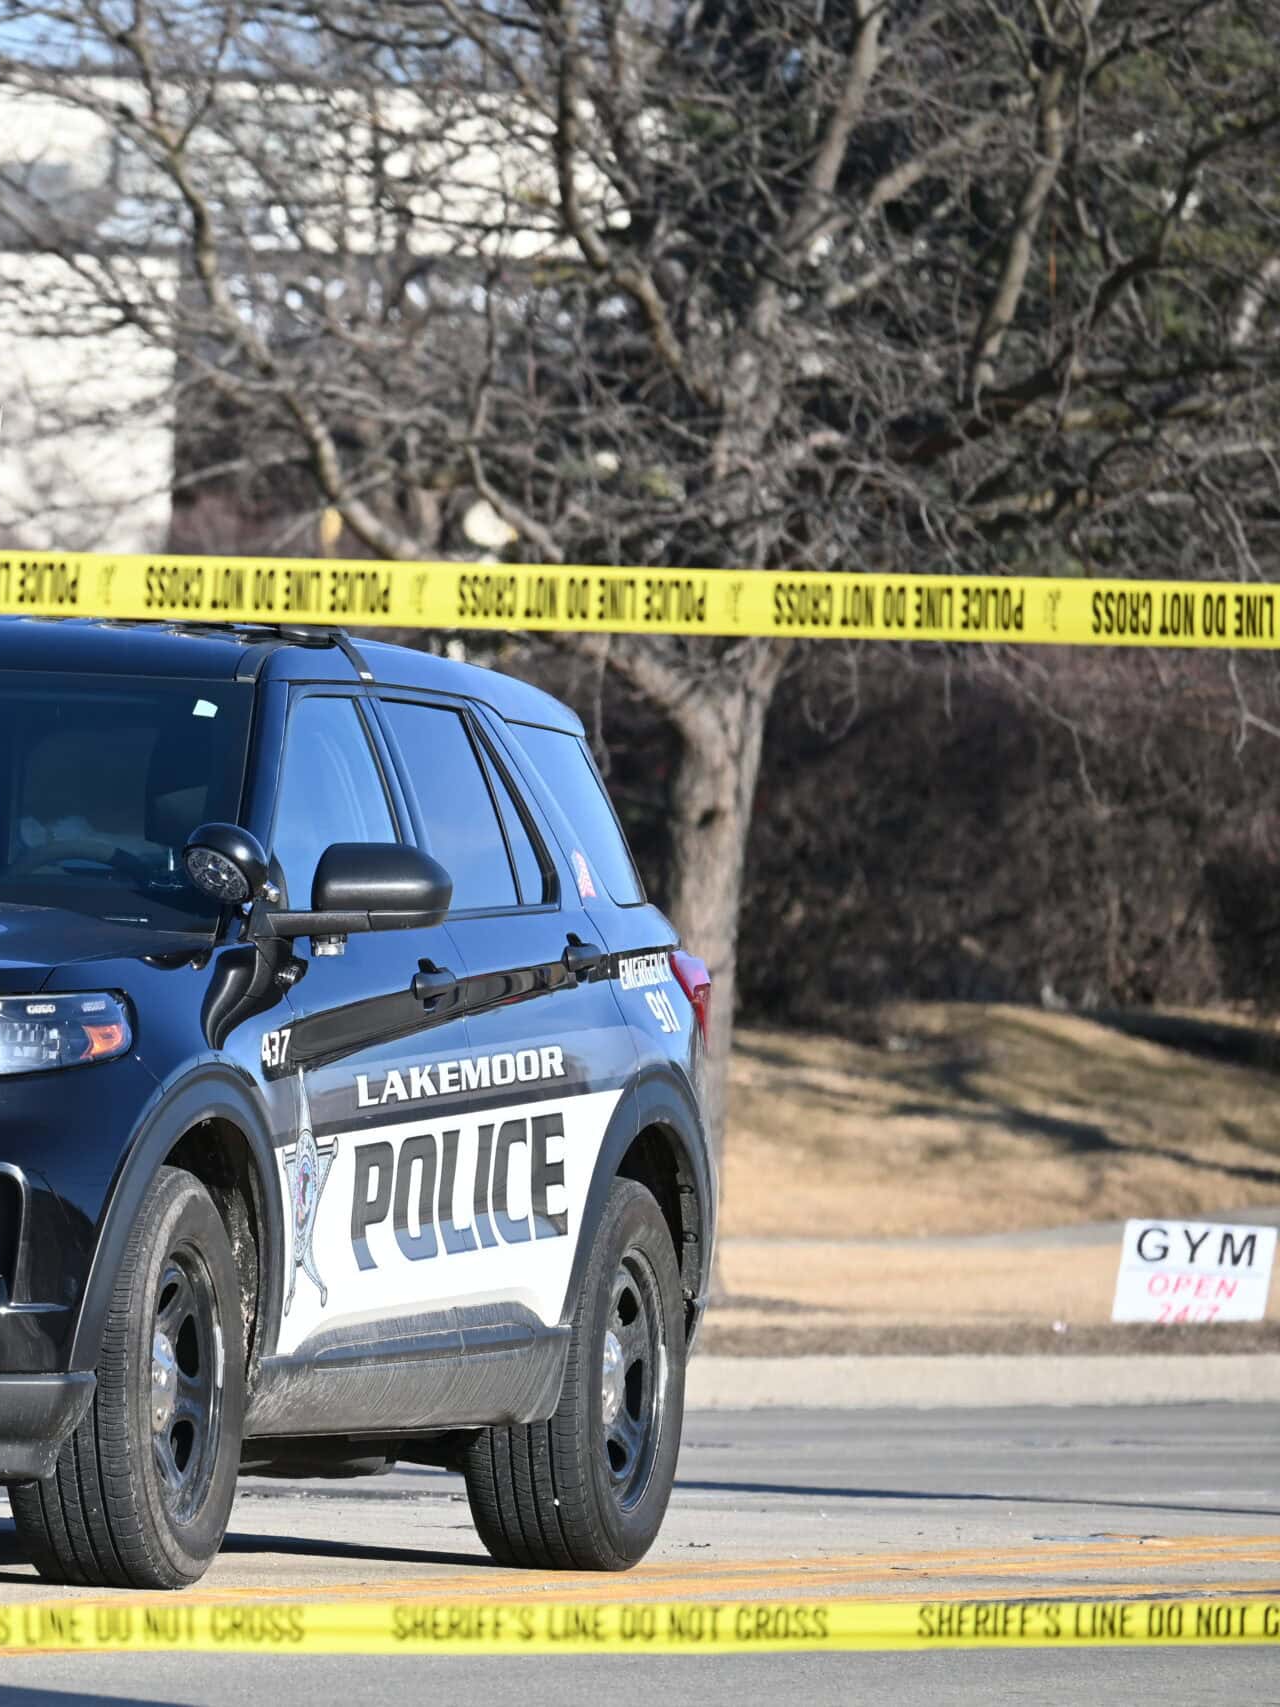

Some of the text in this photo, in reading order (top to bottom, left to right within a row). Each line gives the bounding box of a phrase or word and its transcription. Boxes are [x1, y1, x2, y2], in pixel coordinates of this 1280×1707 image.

[773, 584, 1025, 630] POLICE LINE DO NOT CROSS
[1091, 591, 1275, 638] LINE DO NOT CROSS
[618, 952, 673, 990] EMERGENCY
[643, 989, 681, 1033] 911
[261, 1029, 291, 1066] 437
[355, 1045, 567, 1109] LAKEMOOR
[350, 1112, 569, 1271] POLICE
[1136, 1227, 1257, 1267] GYM
[1147, 1271, 1238, 1299] OPEN
[392, 1605, 829, 1641] SHERIFF'S LINE DO NOT CROSS
[916, 1603, 1062, 1638] SHERIFF'S
[1074, 1605, 1135, 1638] LINE
[1148, 1605, 1184, 1638] DO
[1197, 1605, 1251, 1637] NOT
